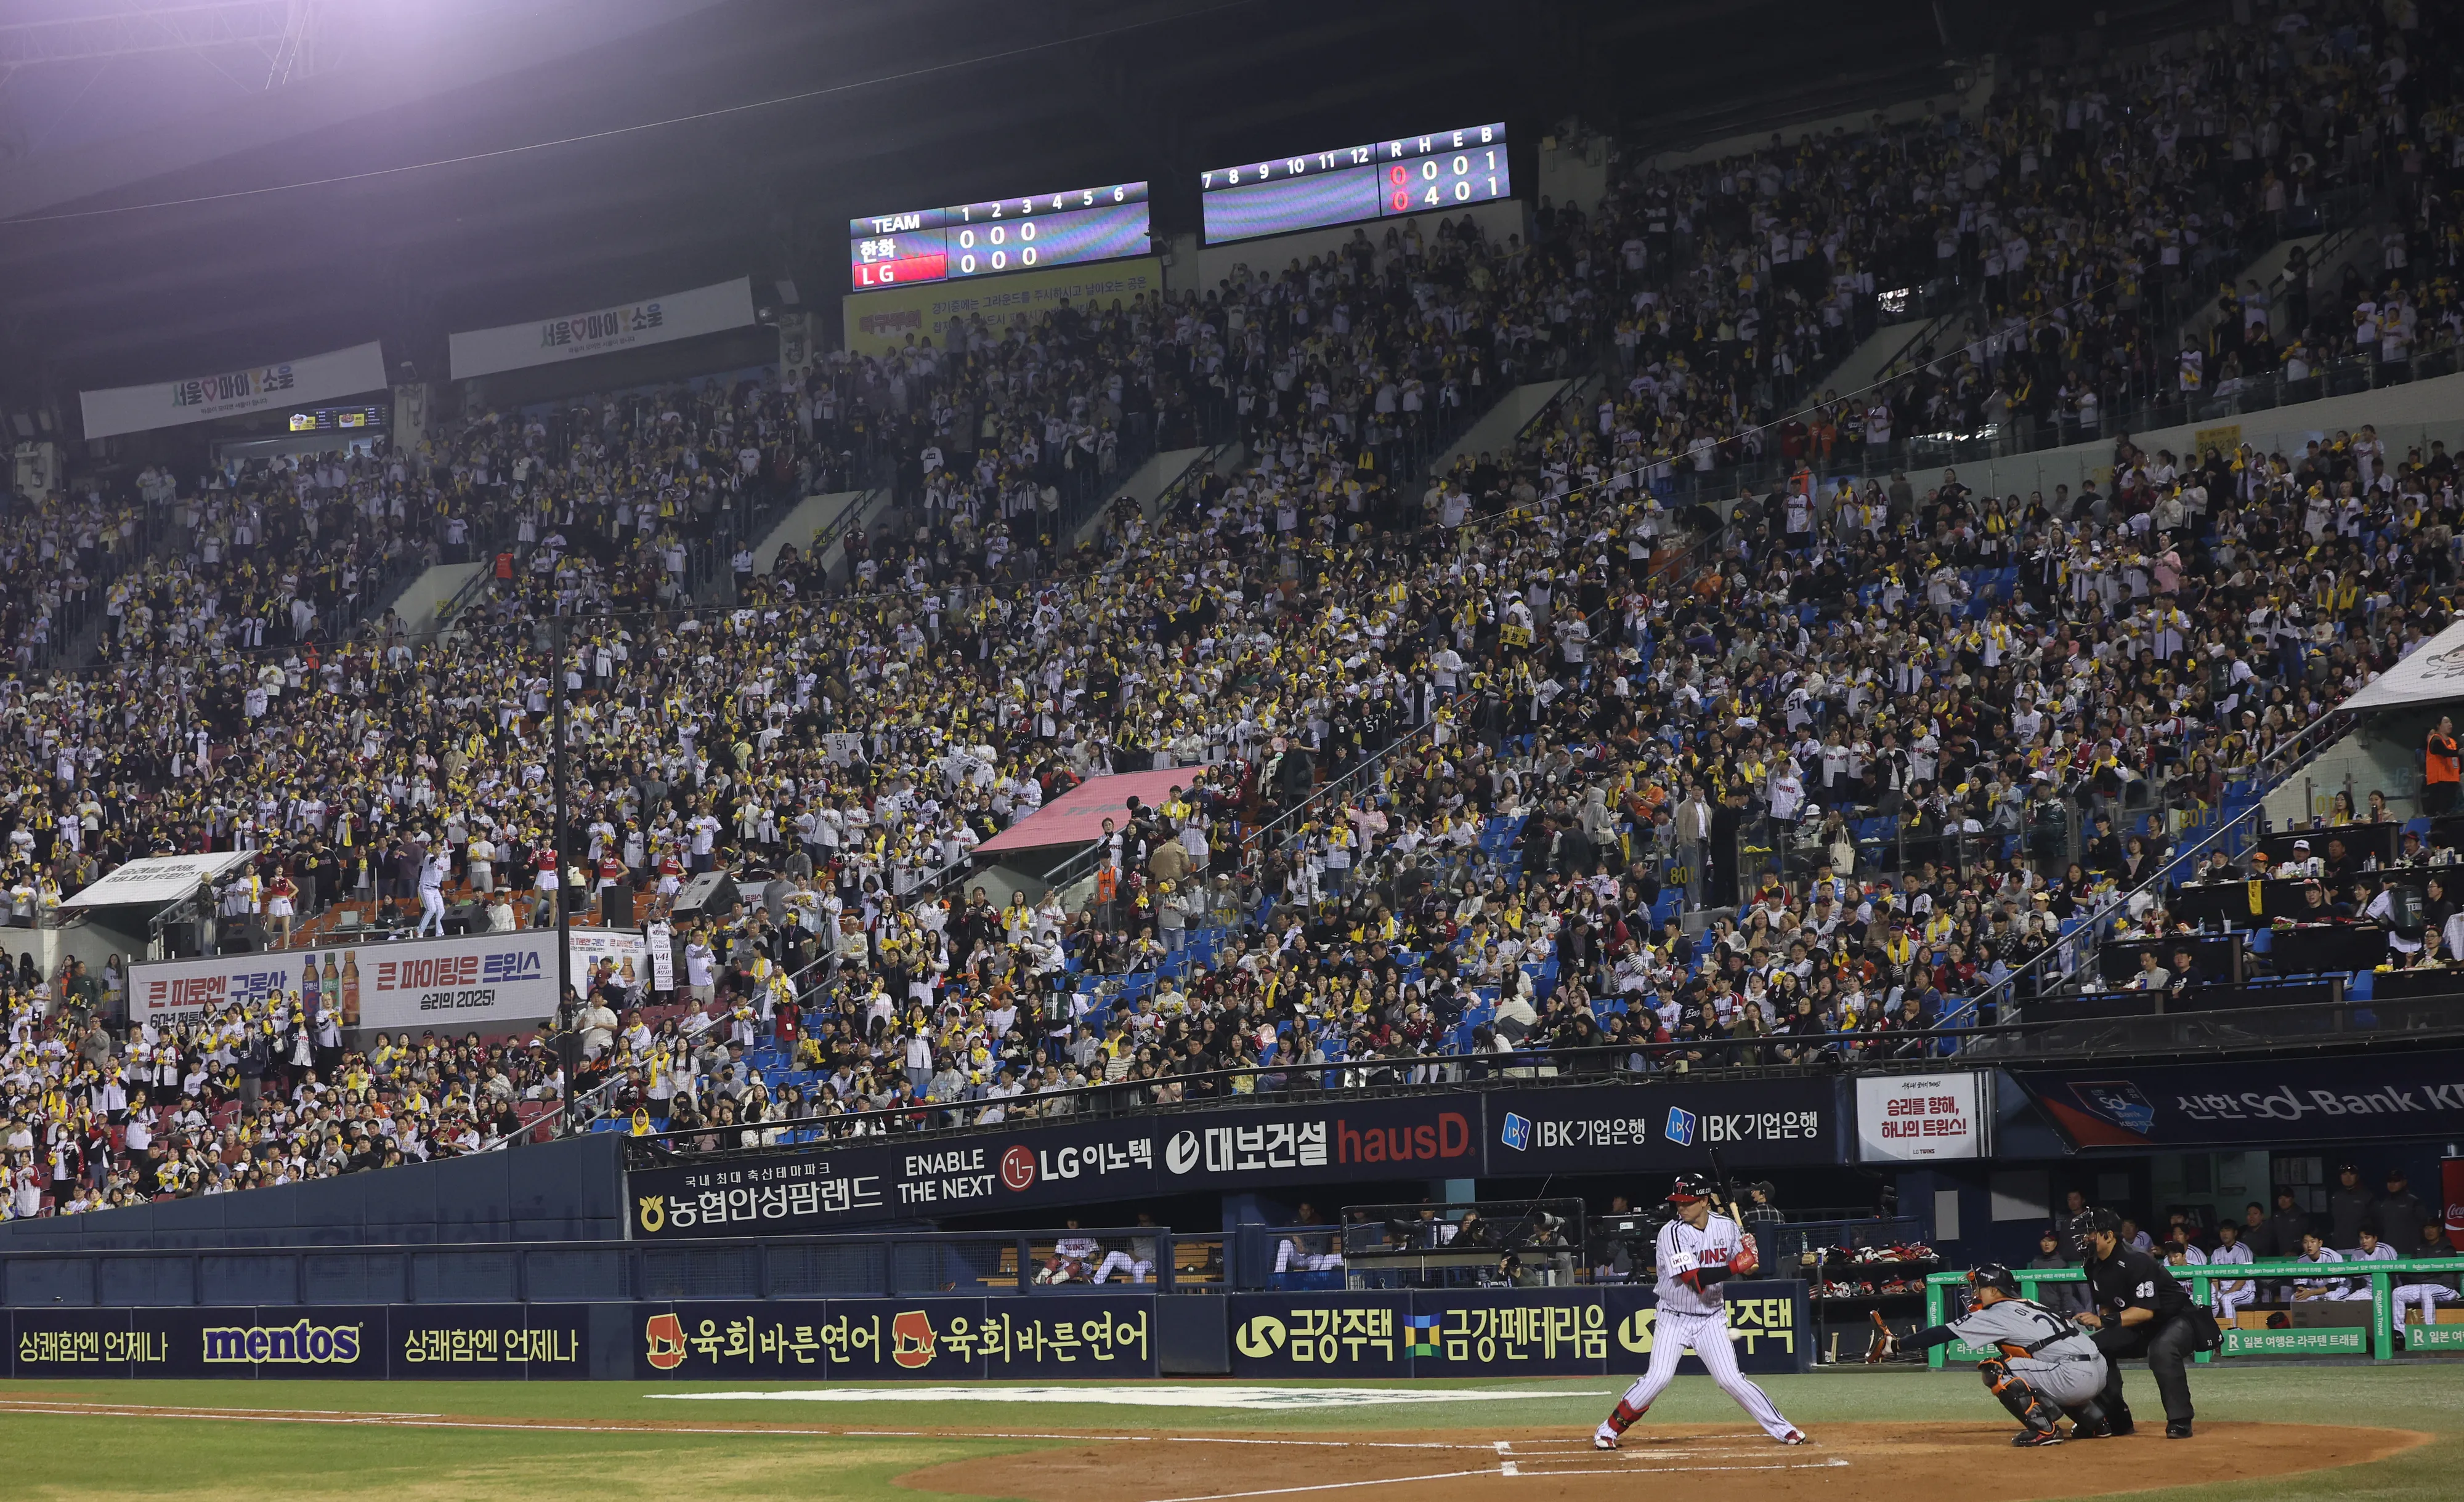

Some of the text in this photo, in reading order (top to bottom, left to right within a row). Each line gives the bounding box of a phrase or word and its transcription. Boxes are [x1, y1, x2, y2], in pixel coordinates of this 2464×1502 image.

[1202, 127, 1492, 188] 7 8 9 10 11 12 R H E B
[1391, 151, 1496, 185] 0 0 0 1
[872, 187, 1124, 233] TEAM 1 2 3 4 5 6
[1393, 177, 1497, 211] 0 4 0 1
[860, 222, 1035, 263] 한화 0 0 0
[961, 247, 1036, 273] 0 0 0
[933, 275, 1147, 315] 경기중에는 그라운드를 주시하시고 날아오는 공은
[541, 303, 663, 349] 서울 소울
[172, 365, 294, 408] 서울 소울
[1788, 697, 1801, 711] 51
[1365, 719, 1379, 730] 51
[837, 740, 846, 750] 51
[1775, 782, 1795, 794] TWINS
[847, 815, 862, 823] TWINS
[377, 951, 541, 991] 큰 파이팅은 트윈스
[149, 971, 287, 1008] 큰 피로엔 구론산
[420, 989, 495, 1011] 승리의 2025!
[1887, 1096, 1959, 1116] 승리를 향해,
[2177, 1093, 2247, 1121] 신한
[2308, 1085, 2426, 1116] Bank
[1204, 1112, 1469, 1172] 대보건설 hausD
[1536, 1118, 1645, 1147] IBK기업은행
[1701, 1111, 1817, 1142] IBK기업은행
[1881, 1118, 1966, 1138] 하나의 트윈스!
[685, 1162, 830, 1188] 국내 최대 축산테마파크
[906, 1149, 984, 1176] ENABLE
[1040, 1137, 1152, 1182] LG이노텍
[22, 1179, 25, 1190] 1
[898, 1174, 995, 1204] THE NEXT
[1676, 1182, 1688, 1193] T
[669, 1176, 883, 1227] 농협안성팜랜드
[2136, 1281, 2155, 1298] 33
[19, 1330, 168, 1362] 상쾌함엔 언제나
[204, 1319, 360, 1363] mentos
[404, 1328, 578, 1362] 상쾌함엔 언제나
[689, 1314, 880, 1365] 육회바른연어
[939, 1310, 1148, 1363] 육회바른연어
[1289, 1309, 1393, 1364] 금강주택
[1443, 1303, 1608, 1363] 금강펜테리움
[2243, 1336, 2263, 1347] 일본
[2266, 1335, 2295, 1347] 여행은
[2298, 1335, 2327, 1347] 라쿠텐
[2330, 1334, 2359, 1347] 트래블
[2430, 1331, 2449, 1344] 일본
